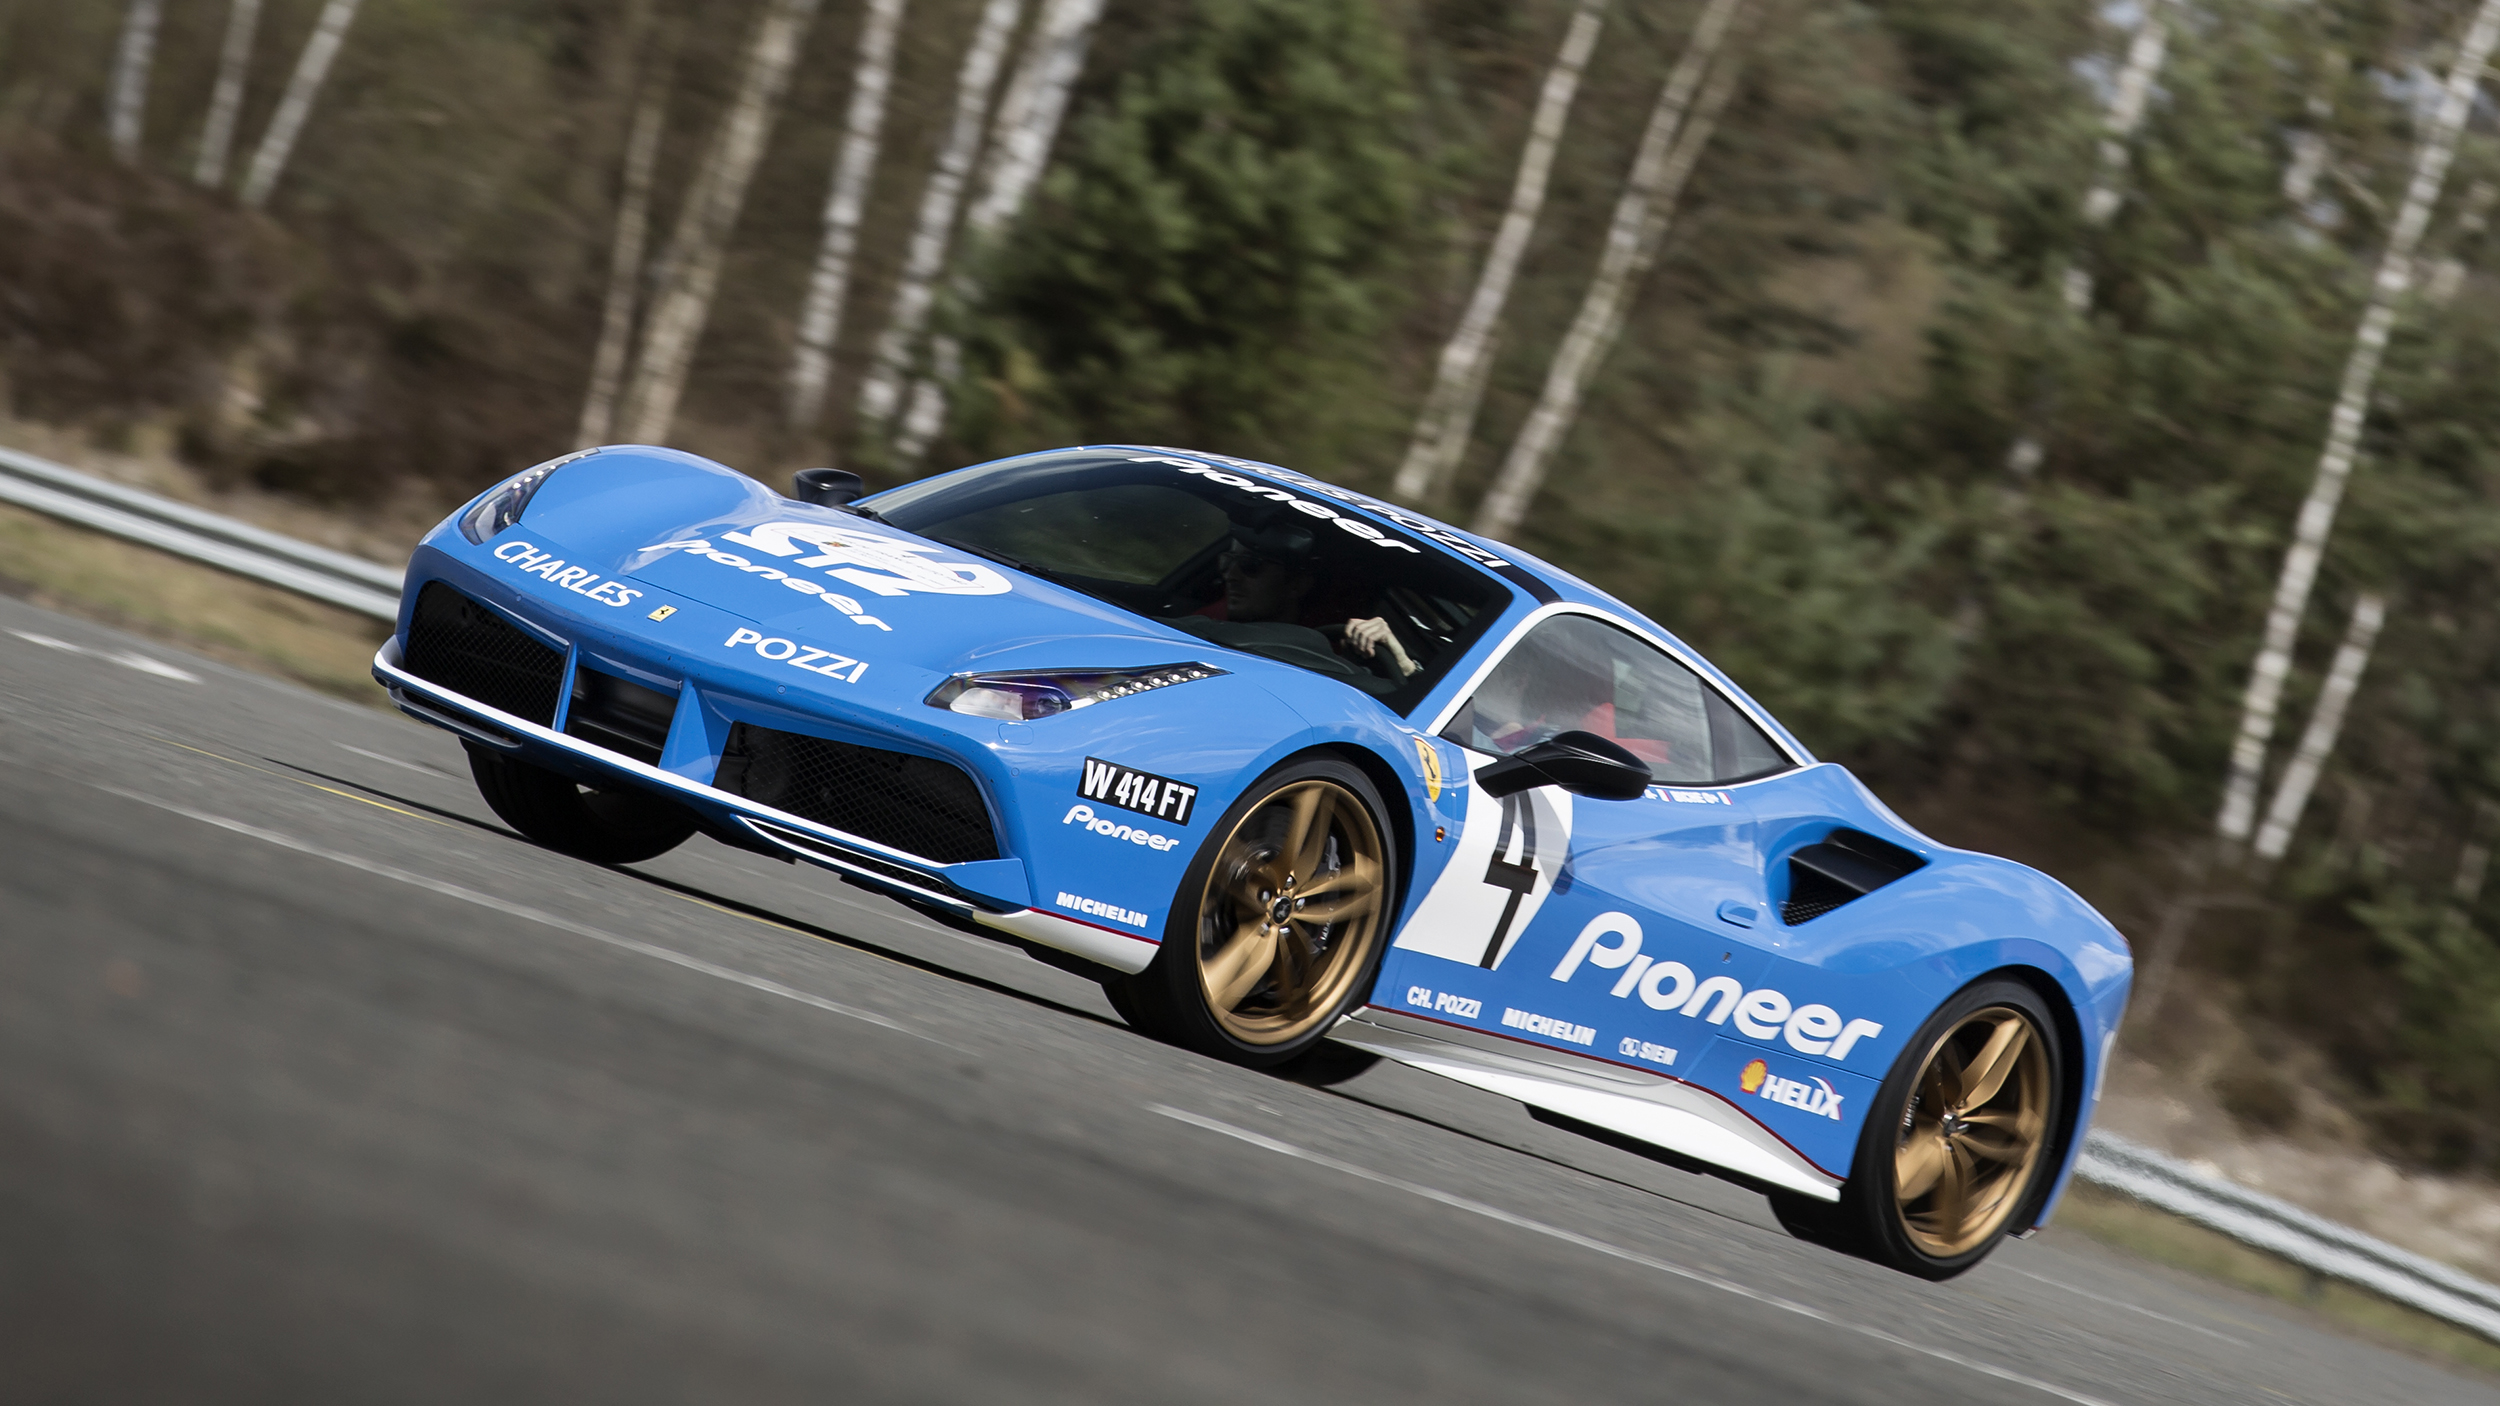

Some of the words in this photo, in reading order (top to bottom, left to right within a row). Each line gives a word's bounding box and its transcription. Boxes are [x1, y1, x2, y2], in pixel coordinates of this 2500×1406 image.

[1127, 457, 1421, 554] Pioneer
[1357, 504, 1511, 568] POZZI
[493, 541, 643, 608] CHARLES
[724, 627, 870, 683] POZZI
[638, 540, 893, 631] Pioneer
[1083, 760, 1117, 799] W
[1115, 772, 1159, 812] 414
[1157, 782, 1196, 821] FT
[1062, 804, 1180, 852] Pioneer
[1055, 891, 1149, 928] MICHELIN
[1407, 986, 1433, 1009] CH.
[1434, 992, 1483, 1020] POZZI
[1550, 911, 1884, 1061] Pioneer
[1501, 1007, 1597, 1046] MICHELIN
[1760, 1073, 1845, 1121] HELIX
